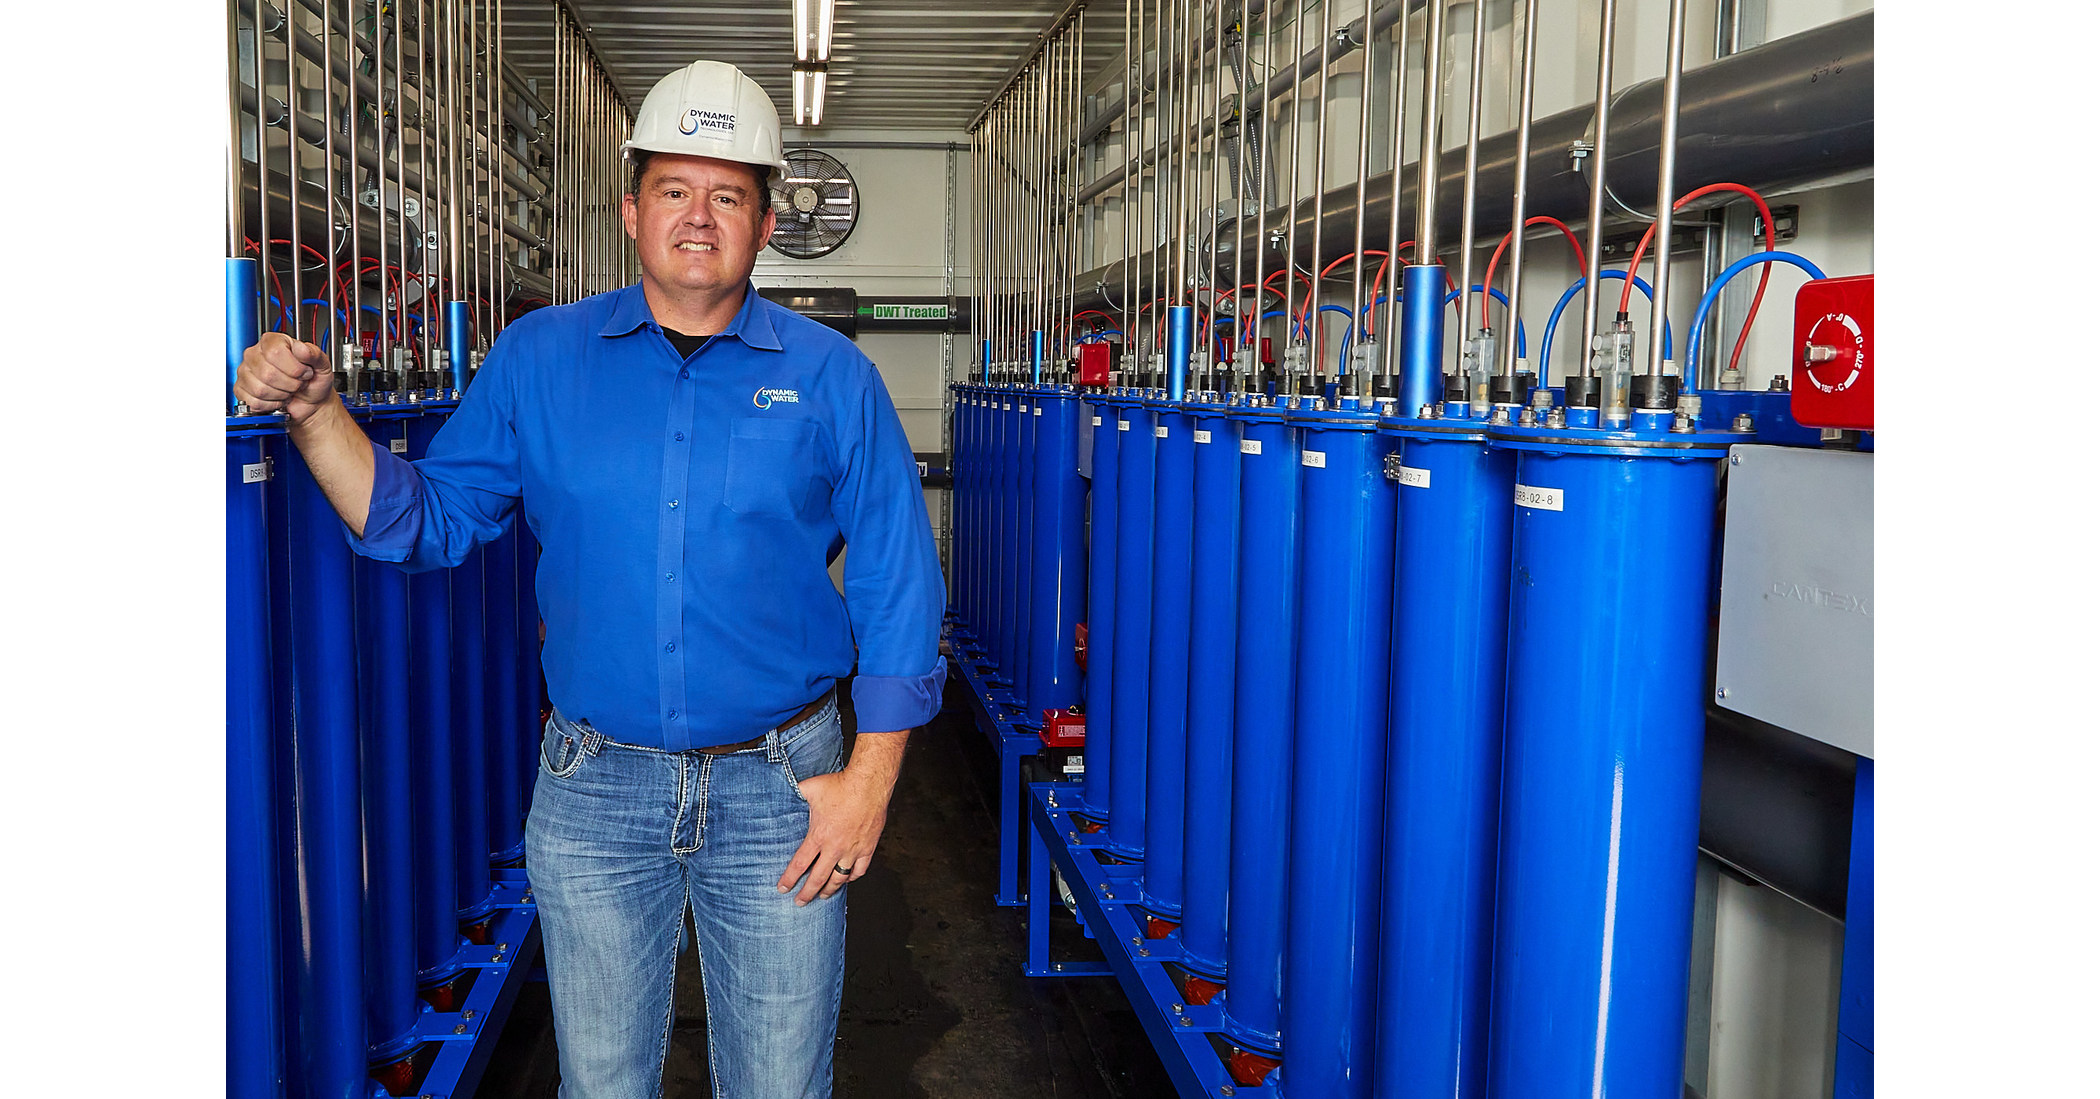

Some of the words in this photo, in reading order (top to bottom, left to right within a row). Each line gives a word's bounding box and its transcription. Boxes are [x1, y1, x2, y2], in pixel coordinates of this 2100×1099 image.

[690, 109, 736, 123] DYNAMIC
[700, 118, 735, 131] WATER
[875, 306, 901, 318] DWT
[903, 306, 946, 318] Treated
[762, 389, 799, 397] DYNAMIC
[770, 395, 800, 404] WATER
[1769, 581, 1868, 616] CANTEX
